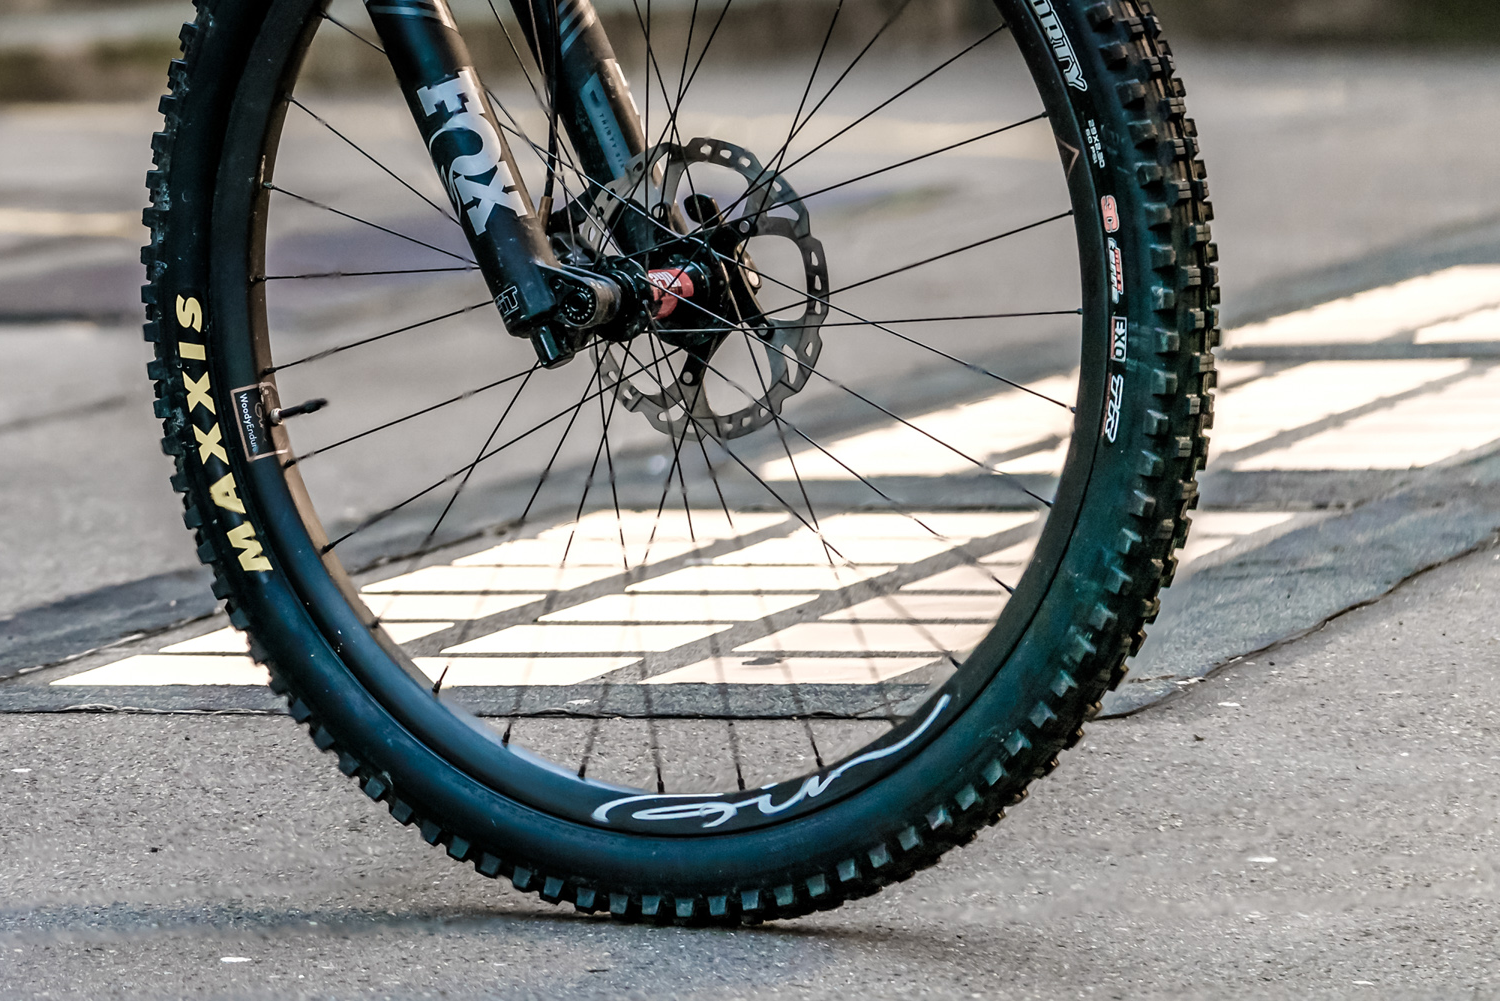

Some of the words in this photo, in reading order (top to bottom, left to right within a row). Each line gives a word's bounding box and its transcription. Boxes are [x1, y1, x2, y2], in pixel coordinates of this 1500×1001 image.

[417, 69, 528, 236] FOX
[176, 294, 273, 572] MAXXIS
[1106, 374, 1125, 443] TR
